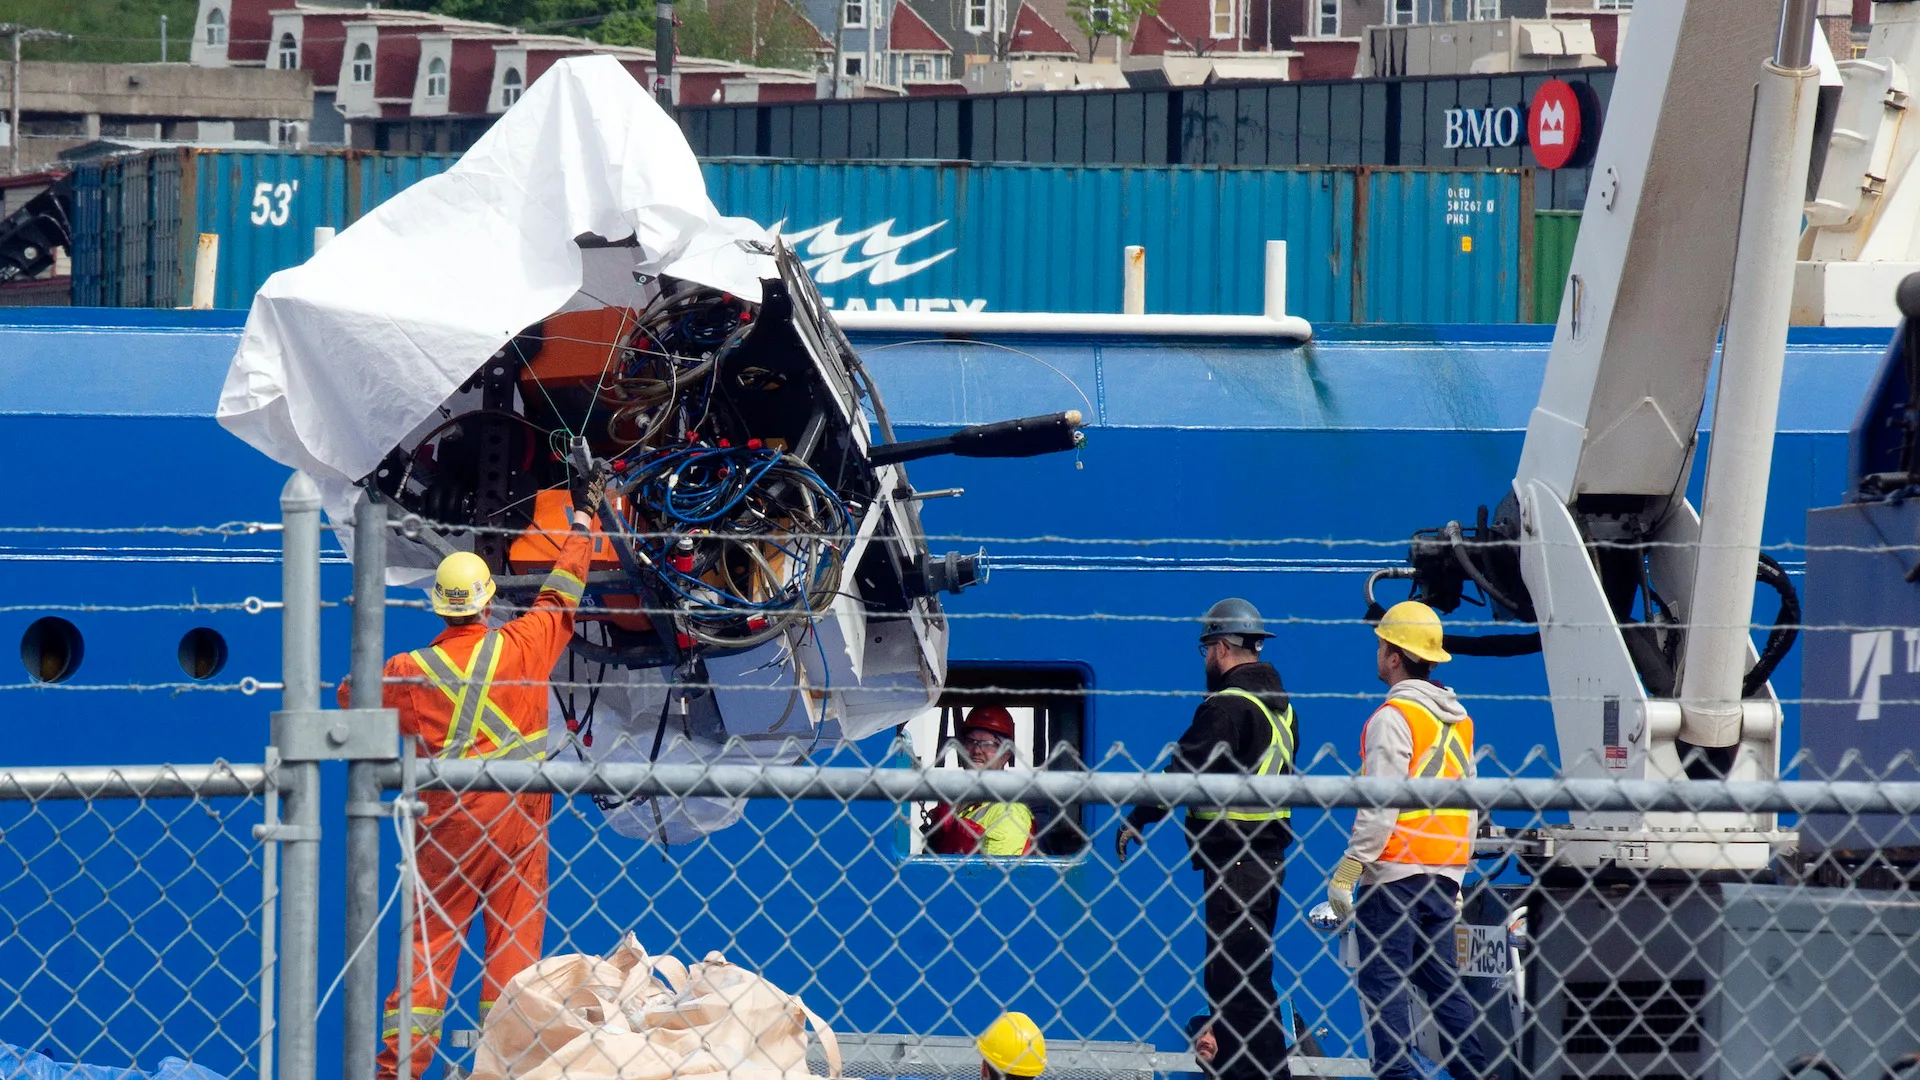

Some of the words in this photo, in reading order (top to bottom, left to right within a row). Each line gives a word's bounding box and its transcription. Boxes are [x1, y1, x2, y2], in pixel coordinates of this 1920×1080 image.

[1443, 107, 1519, 149] BMO
[250, 180, 299, 226] 53'
[1447, 201, 1482, 211] 581267
